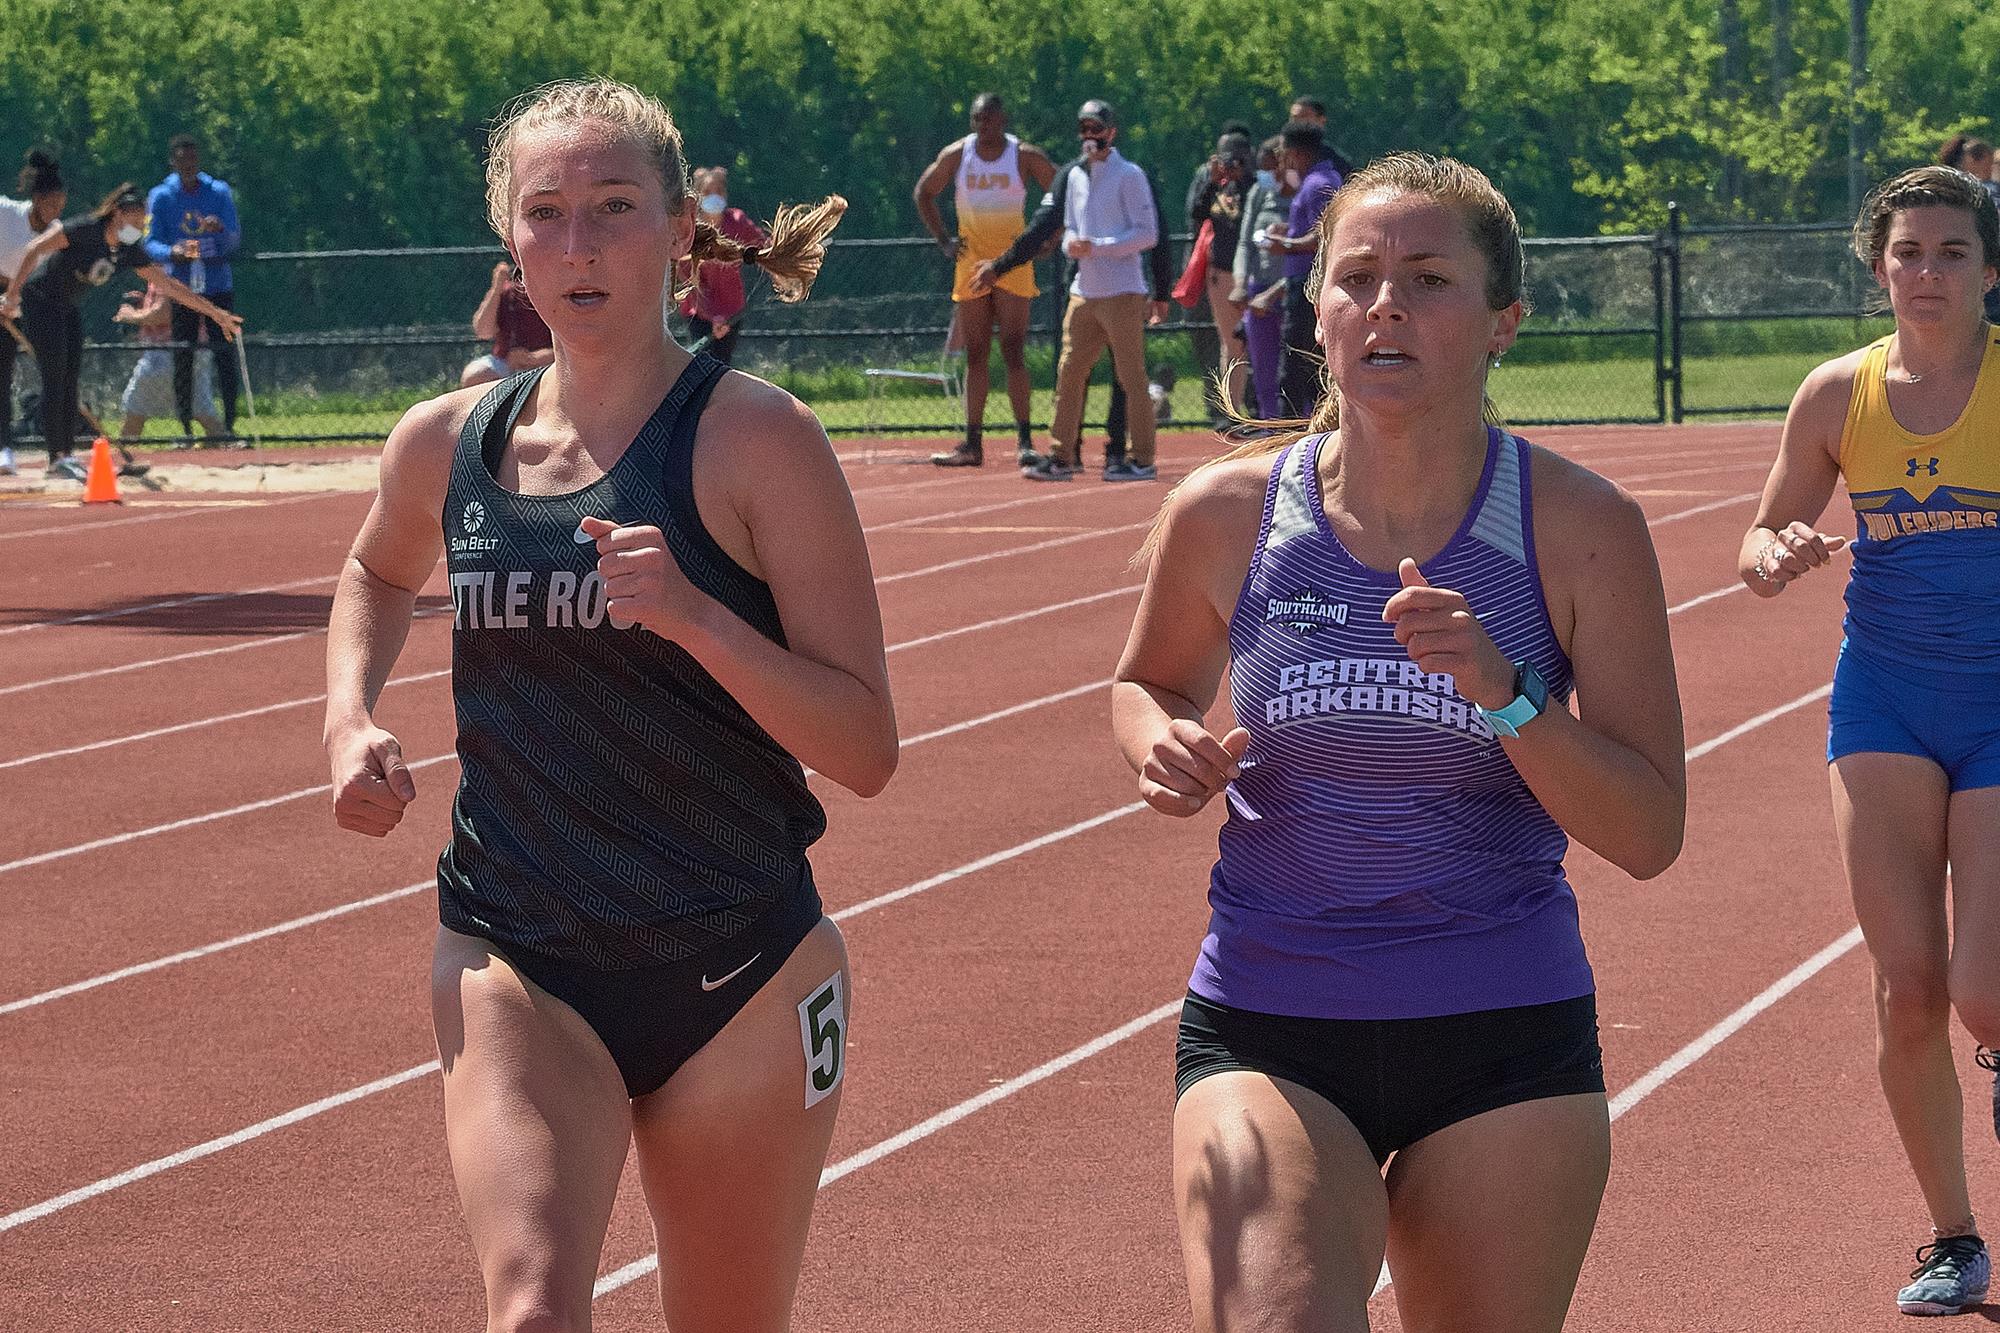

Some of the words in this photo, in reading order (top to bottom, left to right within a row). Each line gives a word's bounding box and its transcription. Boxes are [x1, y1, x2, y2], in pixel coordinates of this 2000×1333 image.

[451, 537, 468, 552] SUN
[468, 536, 499, 550] BELT
[450, 571, 532, 630] TTLE
[547, 571, 648, 630] RO
[1266, 598, 1349, 625] SOUTHLAND
[1279, 658, 1466, 699] CENTRA
[1265, 686, 1494, 740] ARKANSAS
[807, 984, 841, 1091] 5
